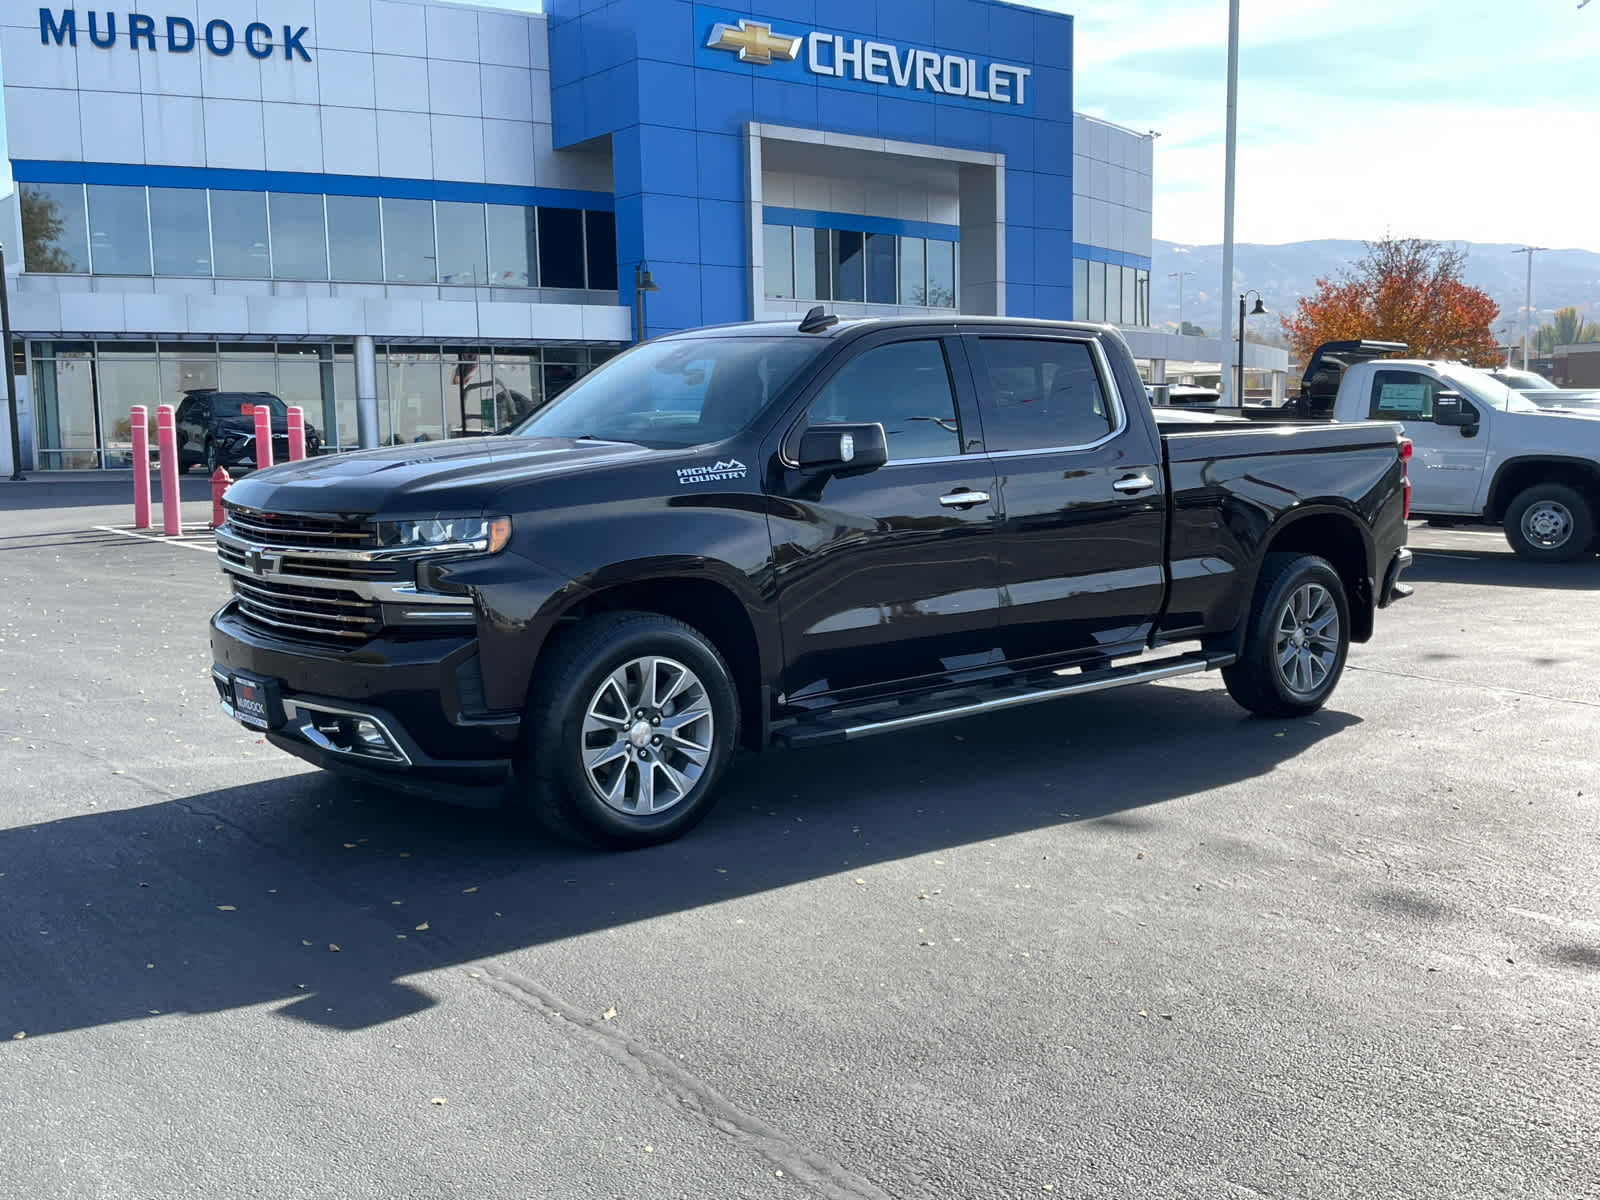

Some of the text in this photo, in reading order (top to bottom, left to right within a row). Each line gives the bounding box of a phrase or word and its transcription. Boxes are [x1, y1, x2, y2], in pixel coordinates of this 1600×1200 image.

[39, 7, 312, 62] MURDOCK
[808, 31, 1032, 105] CHEVROLET
[676, 466, 713, 477] HIGH
[679, 470, 747, 484] COUNTRY
